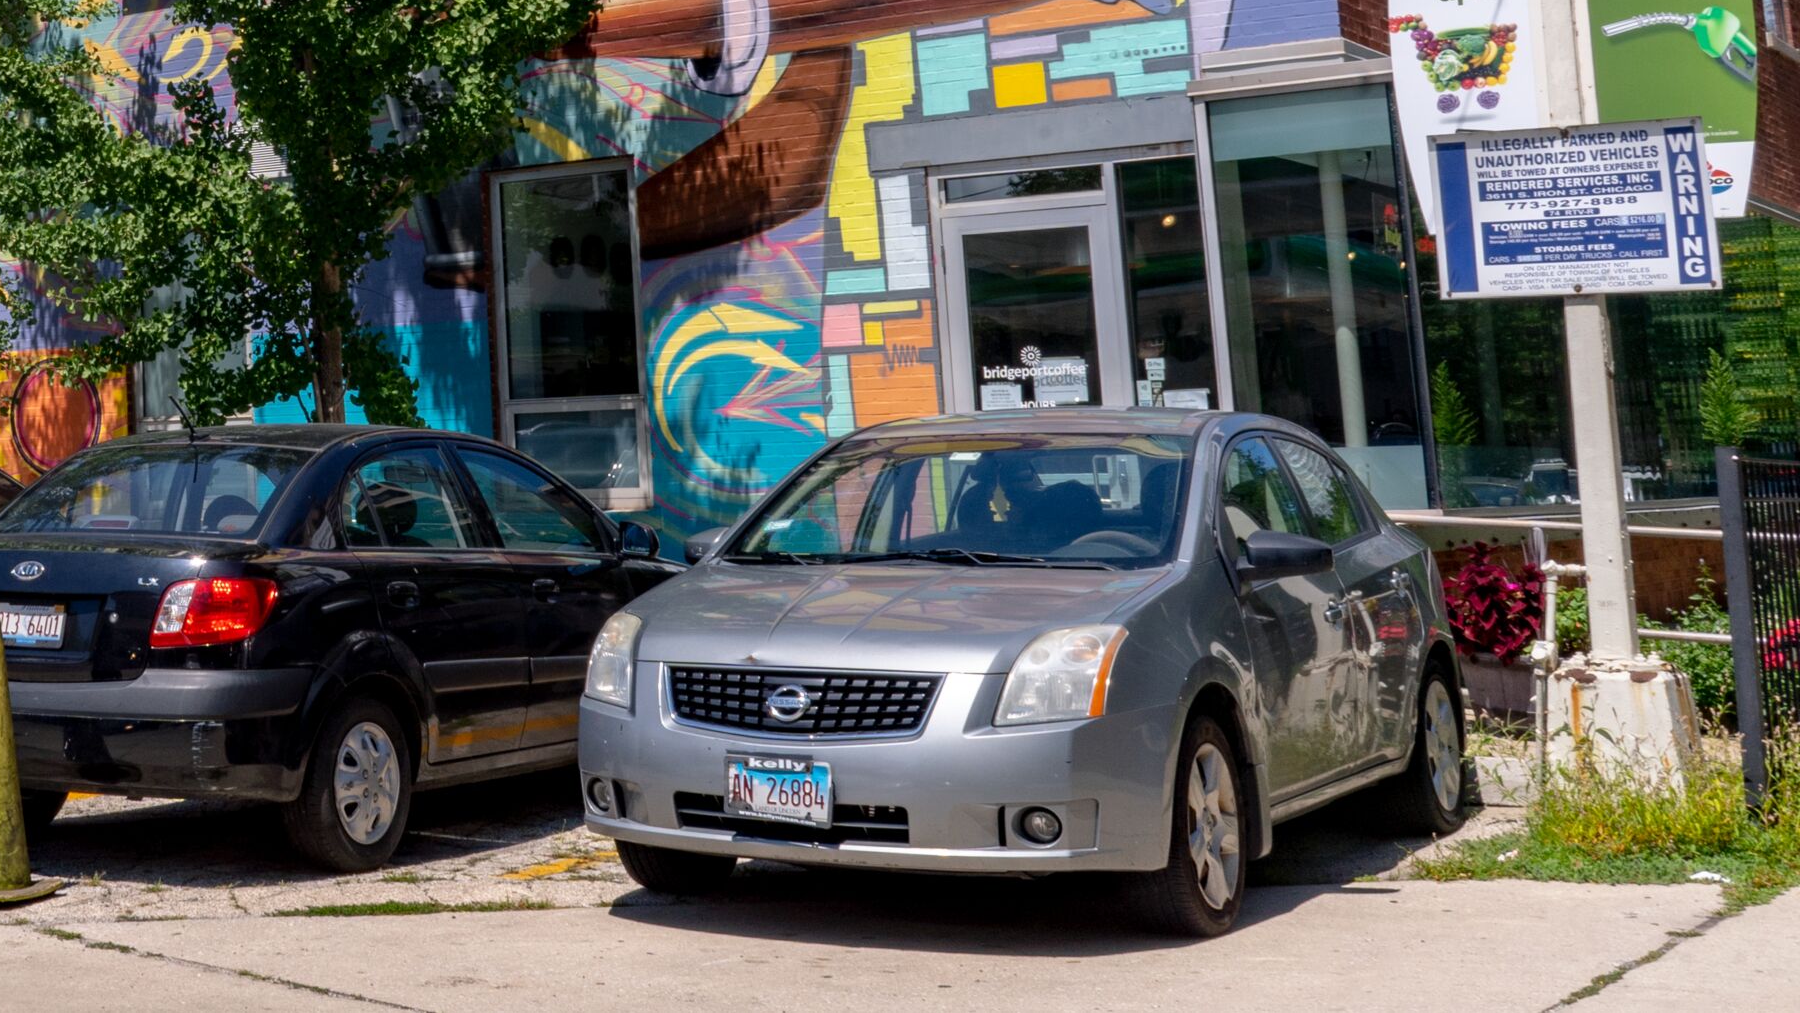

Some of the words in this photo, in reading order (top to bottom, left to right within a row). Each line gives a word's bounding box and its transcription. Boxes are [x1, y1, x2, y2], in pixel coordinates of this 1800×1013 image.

[1482, 136, 1556, 151] ILLEGALLY
[1561, 132, 1615, 146] PARKED
[1620, 130, 1648, 142] AND
[1475, 151, 1585, 168] UNAUTHORIZED
[1590, 146, 1659, 161] VEHICLES
[1477, 170, 1498, 179] WILL
[1501, 169, 1513, 177] BE
[1516, 167, 1546, 177] TOWED
[1550, 167, 1560, 175] AT
[1563, 164, 1600, 174] OWNERS
[1604, 162, 1644, 171] EXPENSE
[1647, 161, 1659, 169] BY
[1486, 179, 1552, 191] RENDERED
[1627, 173, 1653, 184] INC.
[1485, 192, 1512, 200] 3611
[1592, 185, 1653, 194] CHICAGO
[1505, 196, 1638, 210] 773-927-8888
[1667, 133, 1706, 277] WARNING
[1492, 222, 1548, 232] TOWING
[1552, 220, 1587, 229] FEES
[1594, 218, 1618, 227] CARS
[1534, 245, 1584, 253] STORAGE
[1581, 252, 1612, 260] TRUCKS
[983, 363, 1085, 380] bridgeportcoffee
[17, 564, 39, 575] KIA
[138, 578, 159, 586] LX
[27, 614, 59, 637] 6401
[749, 758, 806, 772] kelly
[733, 774, 753, 803] AN
[766, 777, 824, 809] 26884
